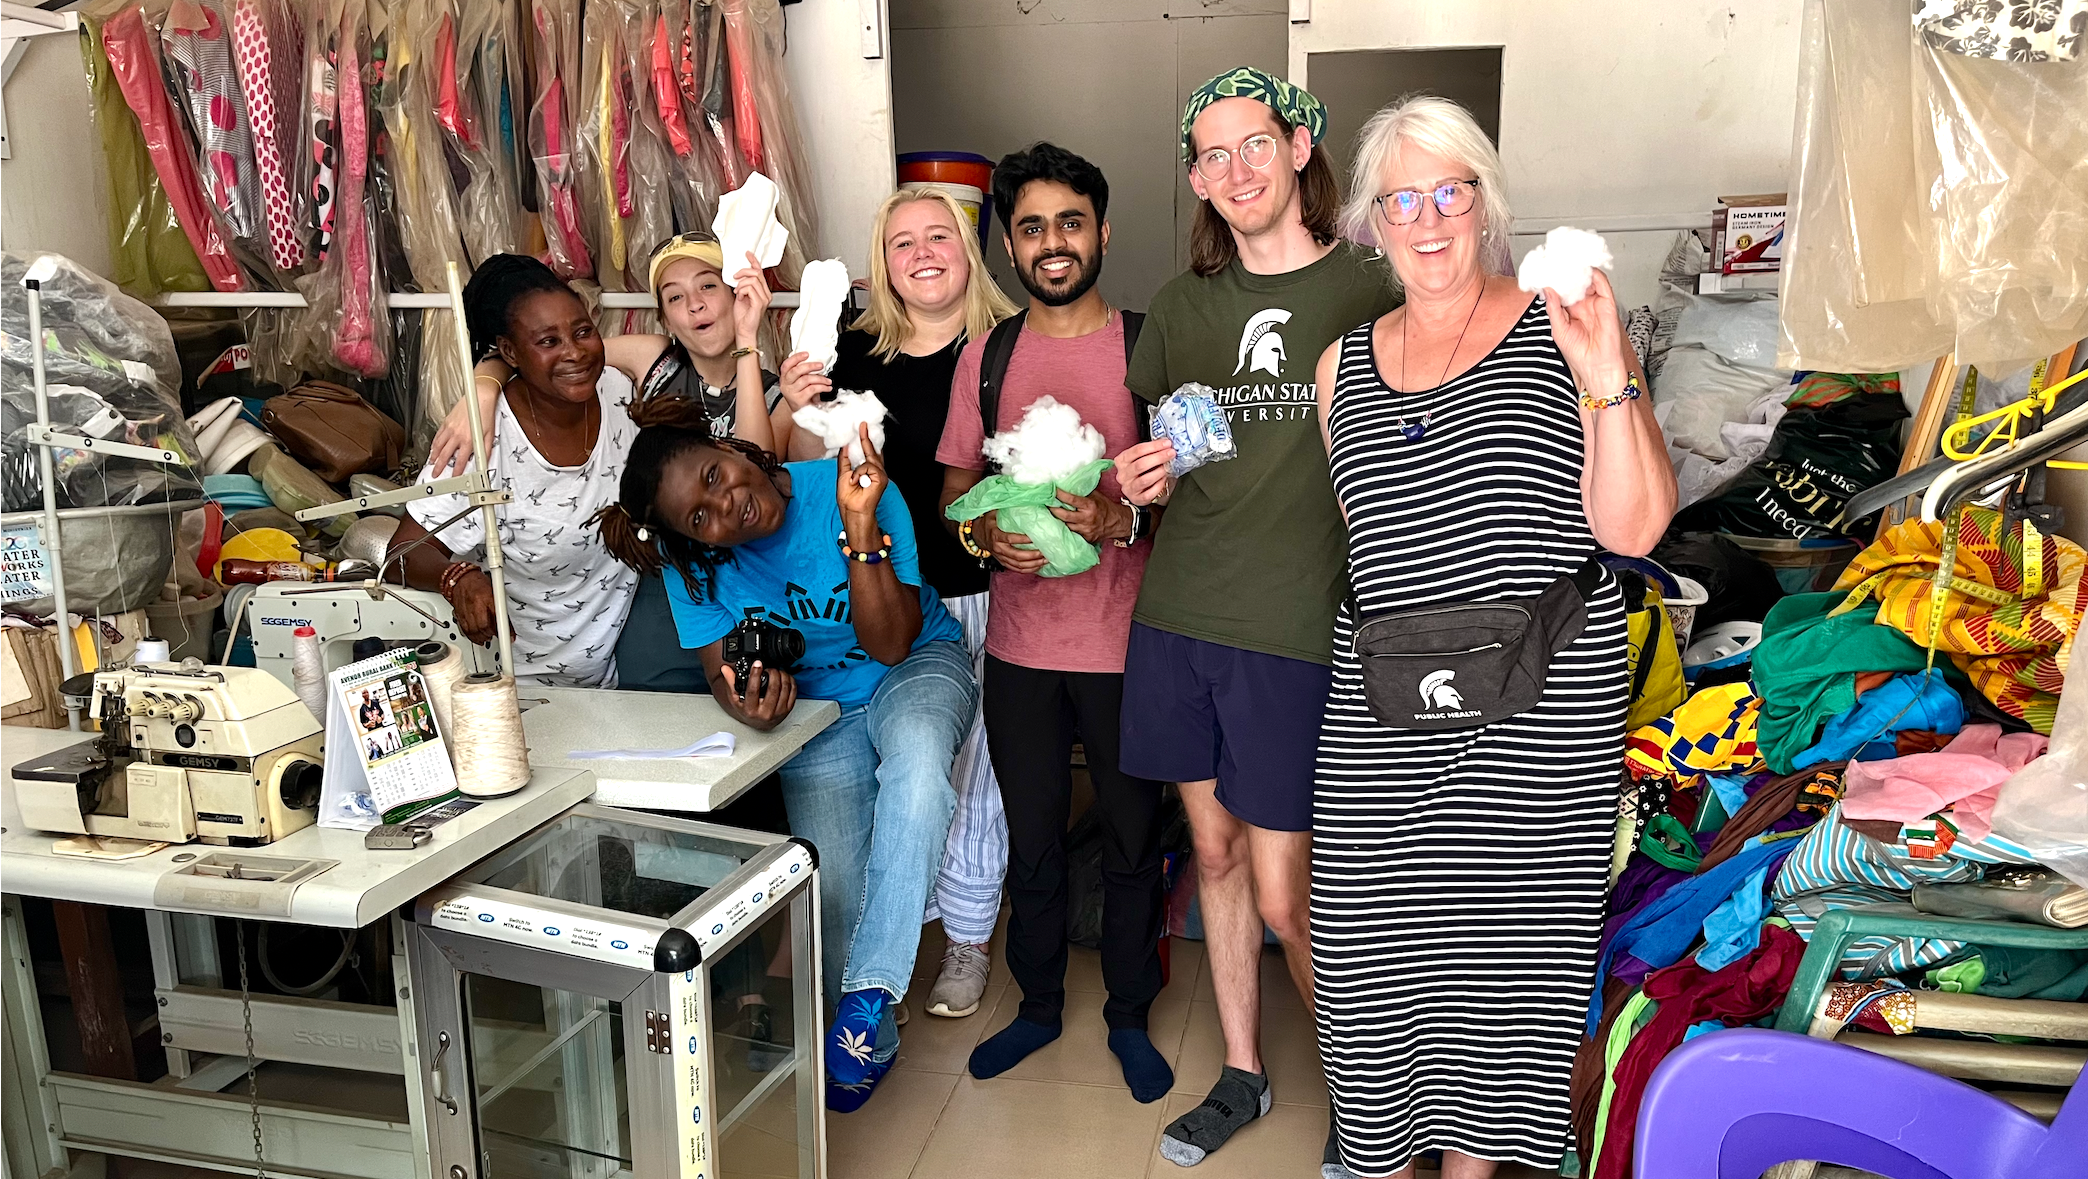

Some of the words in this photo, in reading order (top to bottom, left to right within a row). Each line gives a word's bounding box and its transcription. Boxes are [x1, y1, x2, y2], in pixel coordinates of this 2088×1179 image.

[1279, 382, 1316, 401] STAT
[1226, 406, 1310, 423] VERSIT
[4, 550, 40, 562] ATER
[1, 571, 40, 584] ATER
[1413, 712, 1446, 720] PUBLIC
[1447, 710, 1482, 718] HEALTH
[180, 756, 220, 768] GEMSY
